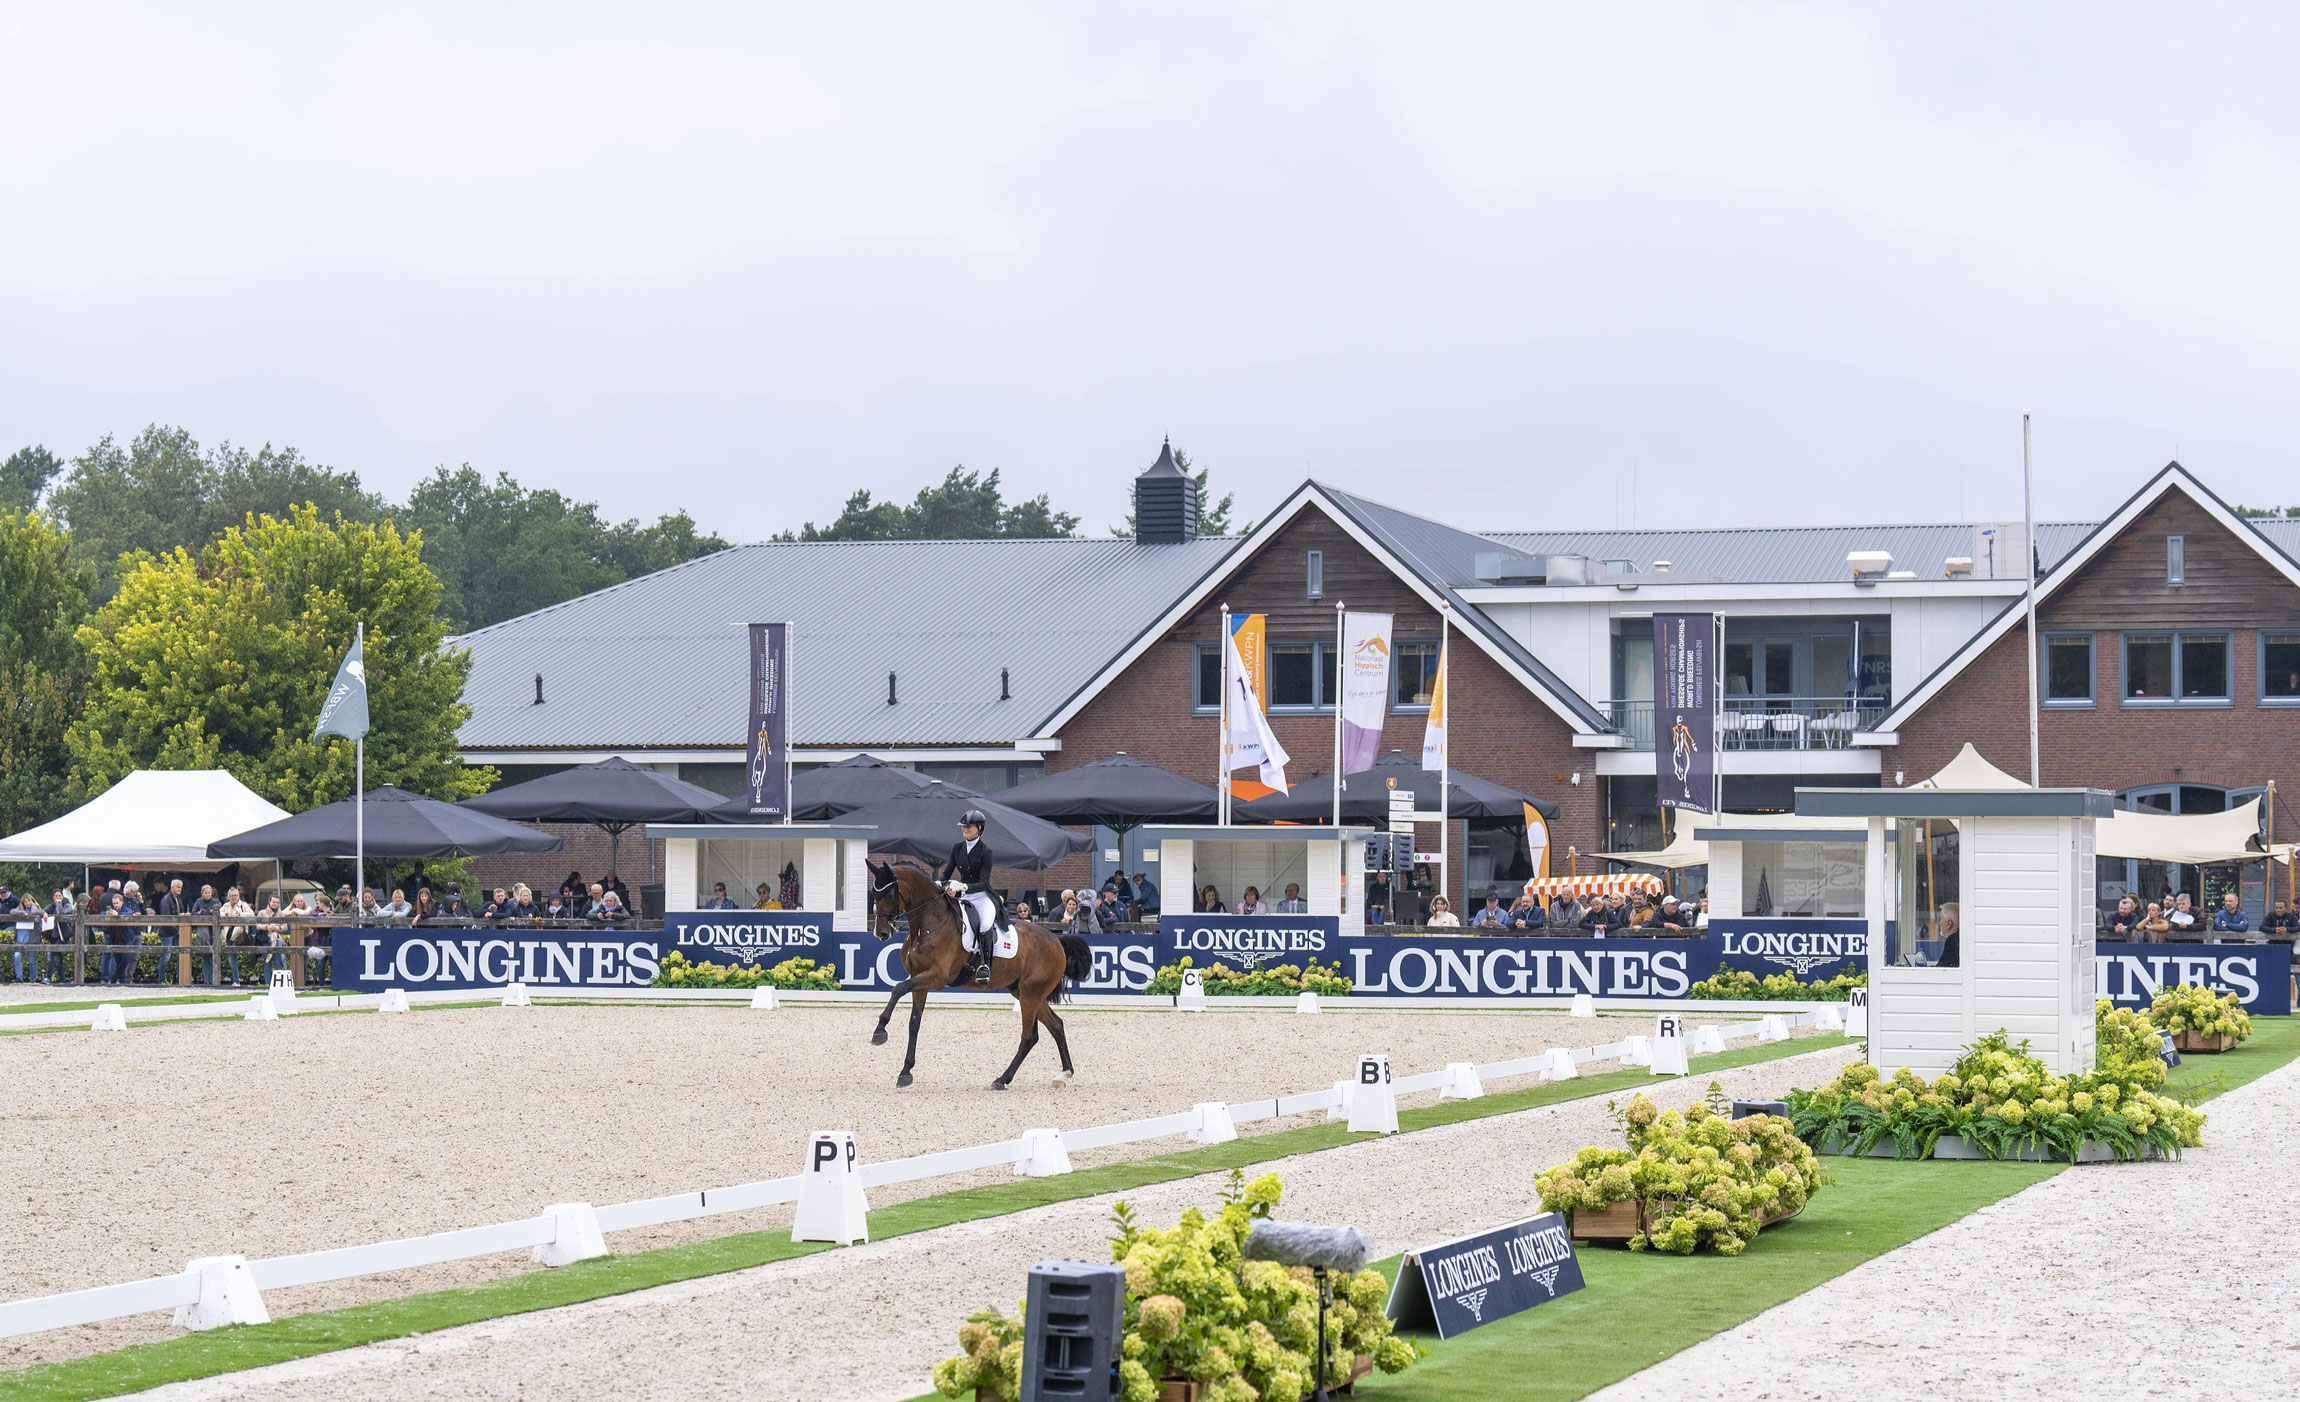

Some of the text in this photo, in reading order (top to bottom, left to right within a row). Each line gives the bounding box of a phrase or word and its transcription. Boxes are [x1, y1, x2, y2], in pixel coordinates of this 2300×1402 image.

[1354, 662, 1384, 670] Hippisch
[1354, 669, 1384, 677] Centrum
[677, 924, 820, 947] LONGINES
[1173, 928, 1326, 952] LONGINES
[1721, 932, 1868, 957] LONGINE
[359, 939, 662, 987] LONGINES
[1349, 947, 1690, 997] LONGINES
[273, 973, 284, 988] H
[287, 973, 293, 988] H
[1184, 972, 1196, 986] C
[1851, 991, 1867, 1007] M
[1660, 1019, 1675, 1038] R
[1361, 1061, 1380, 1085] B
[1383, 1061, 1391, 1085] B
[813, 1140, 838, 1173] P
[845, 1140, 856, 1174] P
[1504, 1225, 1571, 1276] LONGINES
[1428, 1245, 1501, 1300] LONGINES
